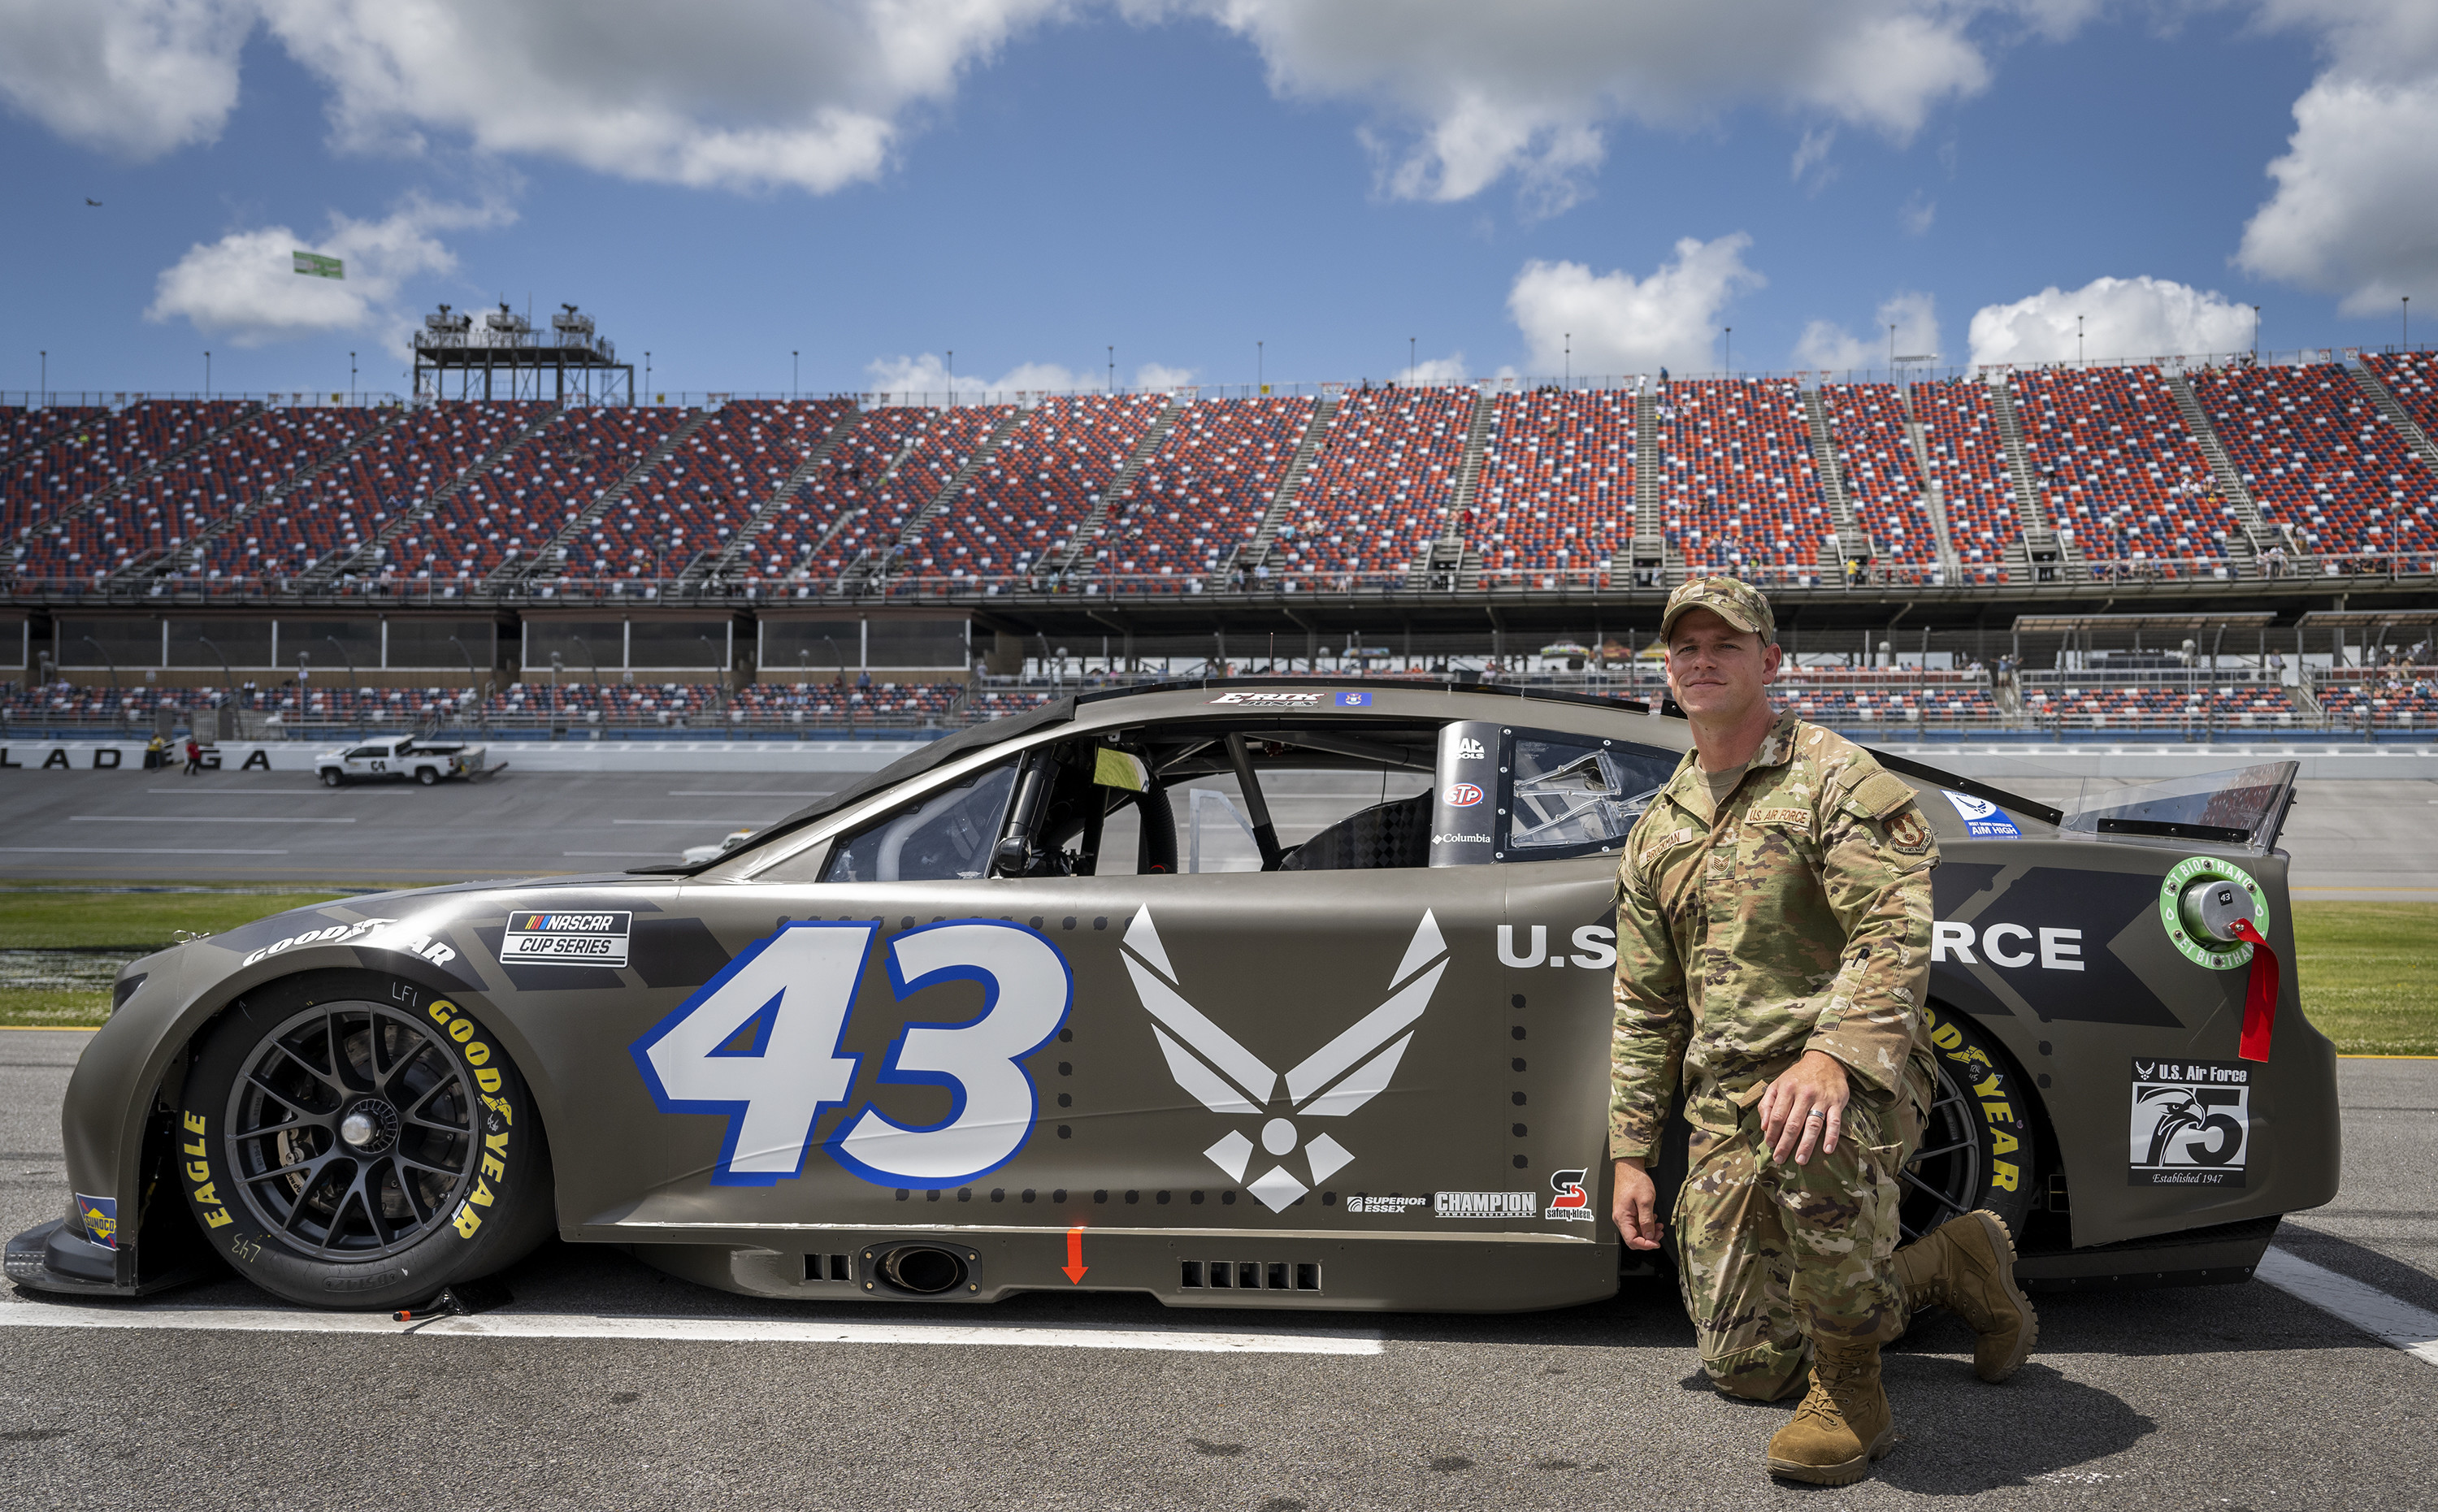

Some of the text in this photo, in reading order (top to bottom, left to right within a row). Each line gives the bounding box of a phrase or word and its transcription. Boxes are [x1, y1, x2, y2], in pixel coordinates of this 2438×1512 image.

[1459, 738, 1485, 753] AC
[1447, 786, 1479, 804] STP
[1749, 809, 1807, 823] U.S. AIR FORCE
[1442, 833, 1490, 843] Columbia
[1972, 826, 2018, 835] AIM HIGH
[1646, 832, 1680, 861] BROCKMAN
[2220, 893, 2231, 902] 43
[546, 916, 614, 931] NASCAR
[519, 938, 612, 954] CUP SERIES
[1931, 921, 2084, 972] RCE
[629, 919, 1073, 1189] 43
[2158, 1064, 2247, 1082] U.S. Air Force
[429, 1000, 510, 1239] GOODYEAR
[2137, 1085, 2243, 1165] 75
[184, 1110, 233, 1228] EAGLE
[2153, 1172, 2223, 1184] Established 1947
[1364, 1196, 1426, 1206] SUPERIOR
[1364, 1205, 1406, 1213] ESSEX
[1436, 1193, 1535, 1212] CHAMPION
[85, 1215, 115, 1233] SUNOCO
